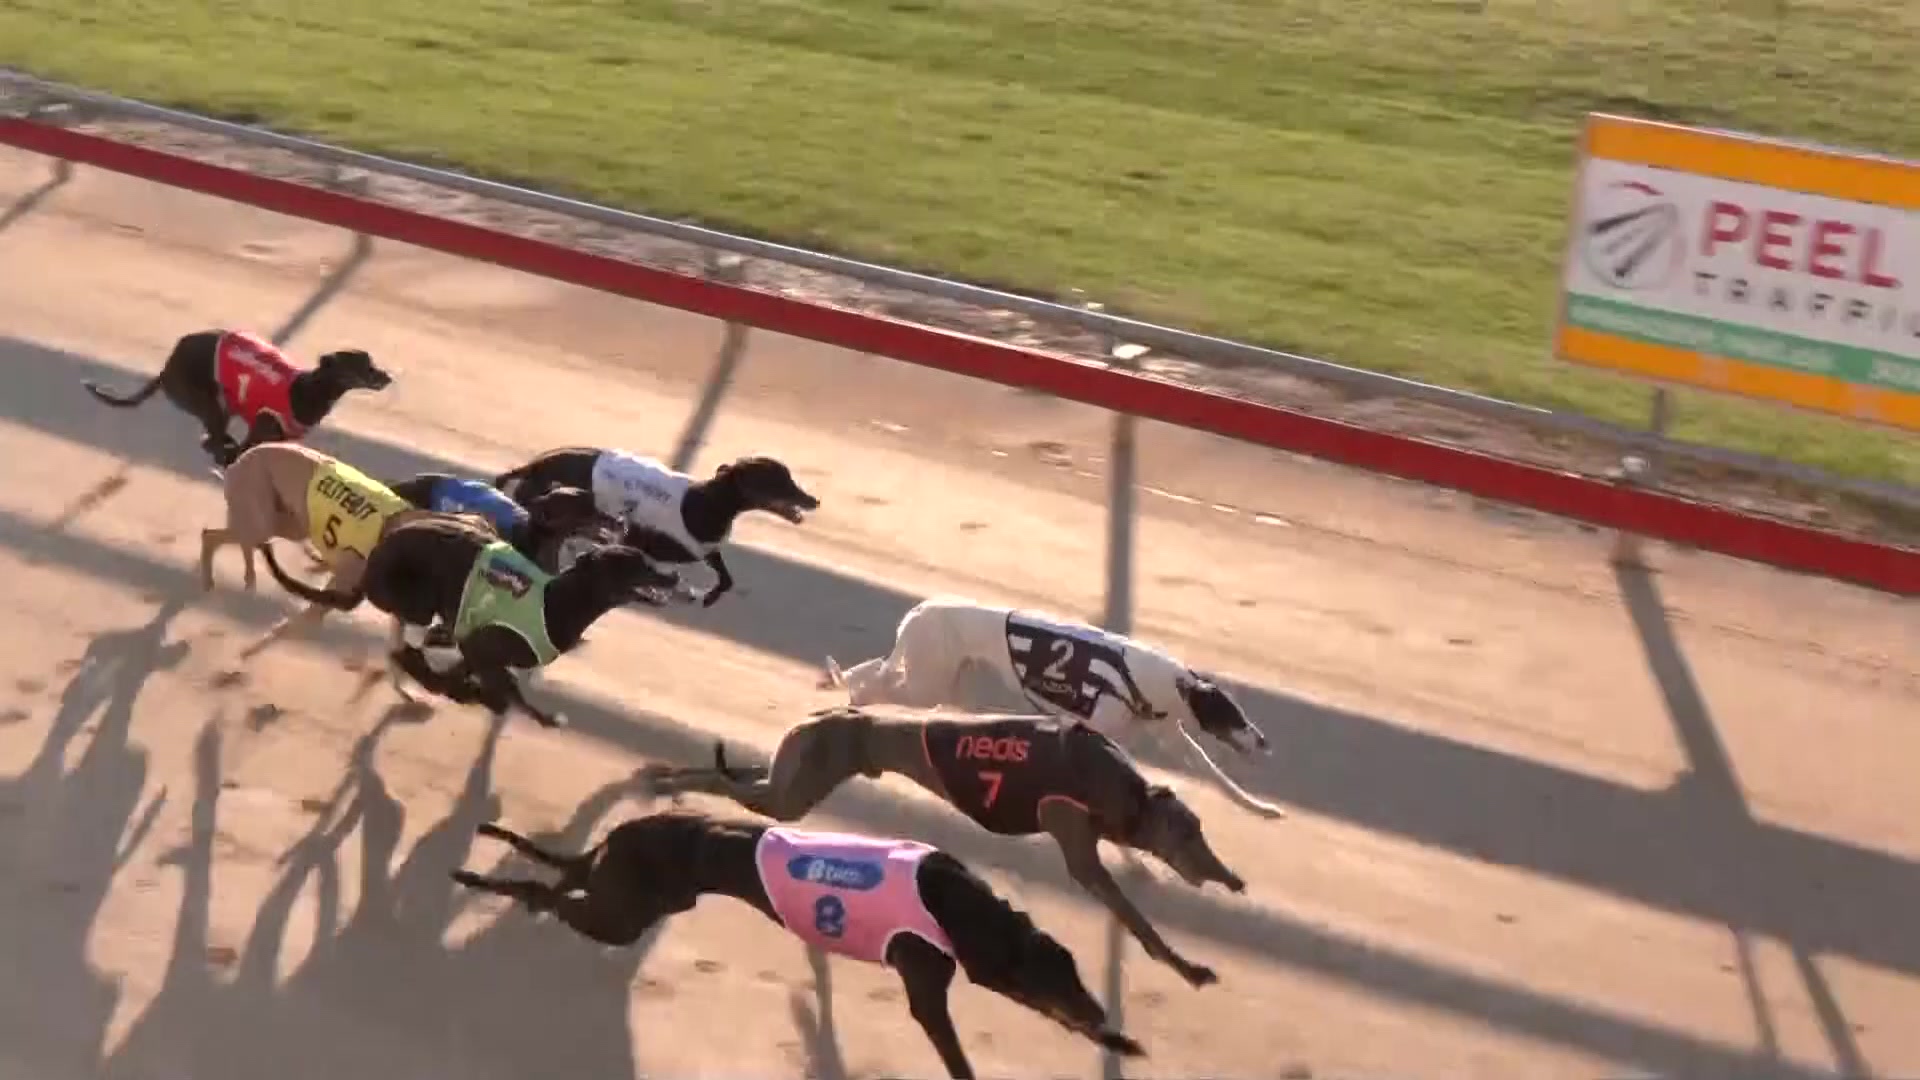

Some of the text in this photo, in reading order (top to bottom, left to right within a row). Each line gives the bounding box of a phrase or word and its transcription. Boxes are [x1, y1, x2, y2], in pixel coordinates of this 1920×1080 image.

[1698, 201, 1903, 289] PEEL
[238, 374, 251, 404] 1
[322, 514, 342, 550] 5
[1042, 639, 1074, 681] 2
[955, 734, 1030, 761] neds
[978, 770, 1003, 809] 7
[816, 894, 845, 939] 8
